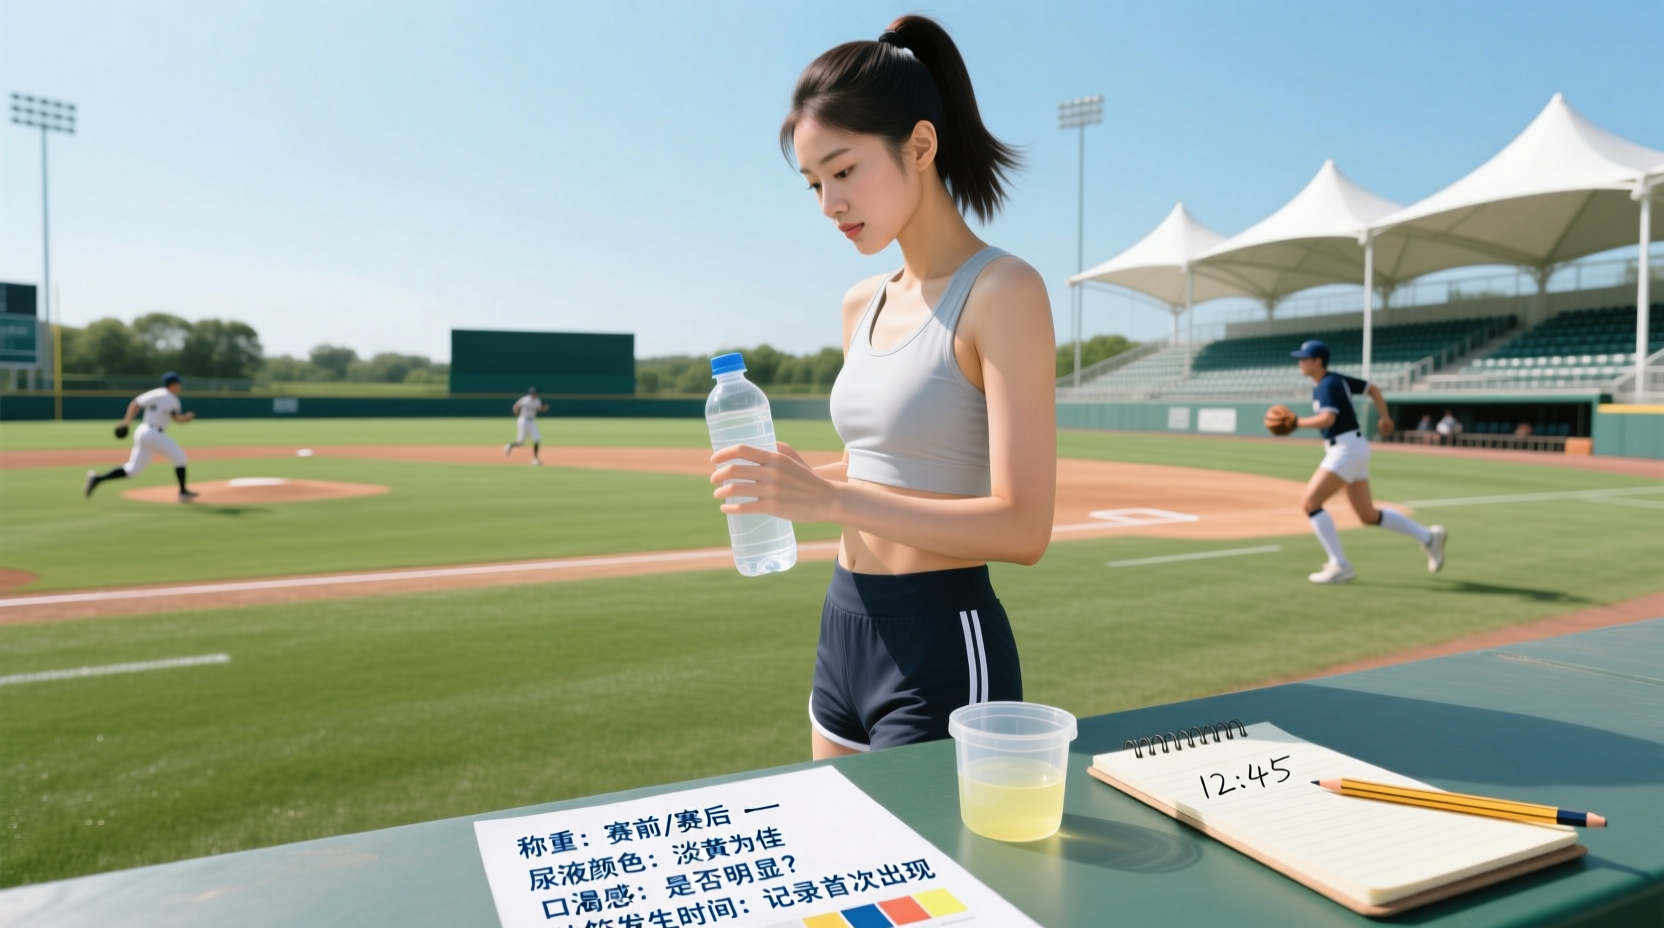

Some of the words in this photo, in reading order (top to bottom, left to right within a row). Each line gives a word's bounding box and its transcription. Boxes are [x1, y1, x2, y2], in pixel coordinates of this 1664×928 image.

[1199, 755, 1291, 799] 12:45
[529, 826, 786, 892] 尿液颜色：淡黄为佳
